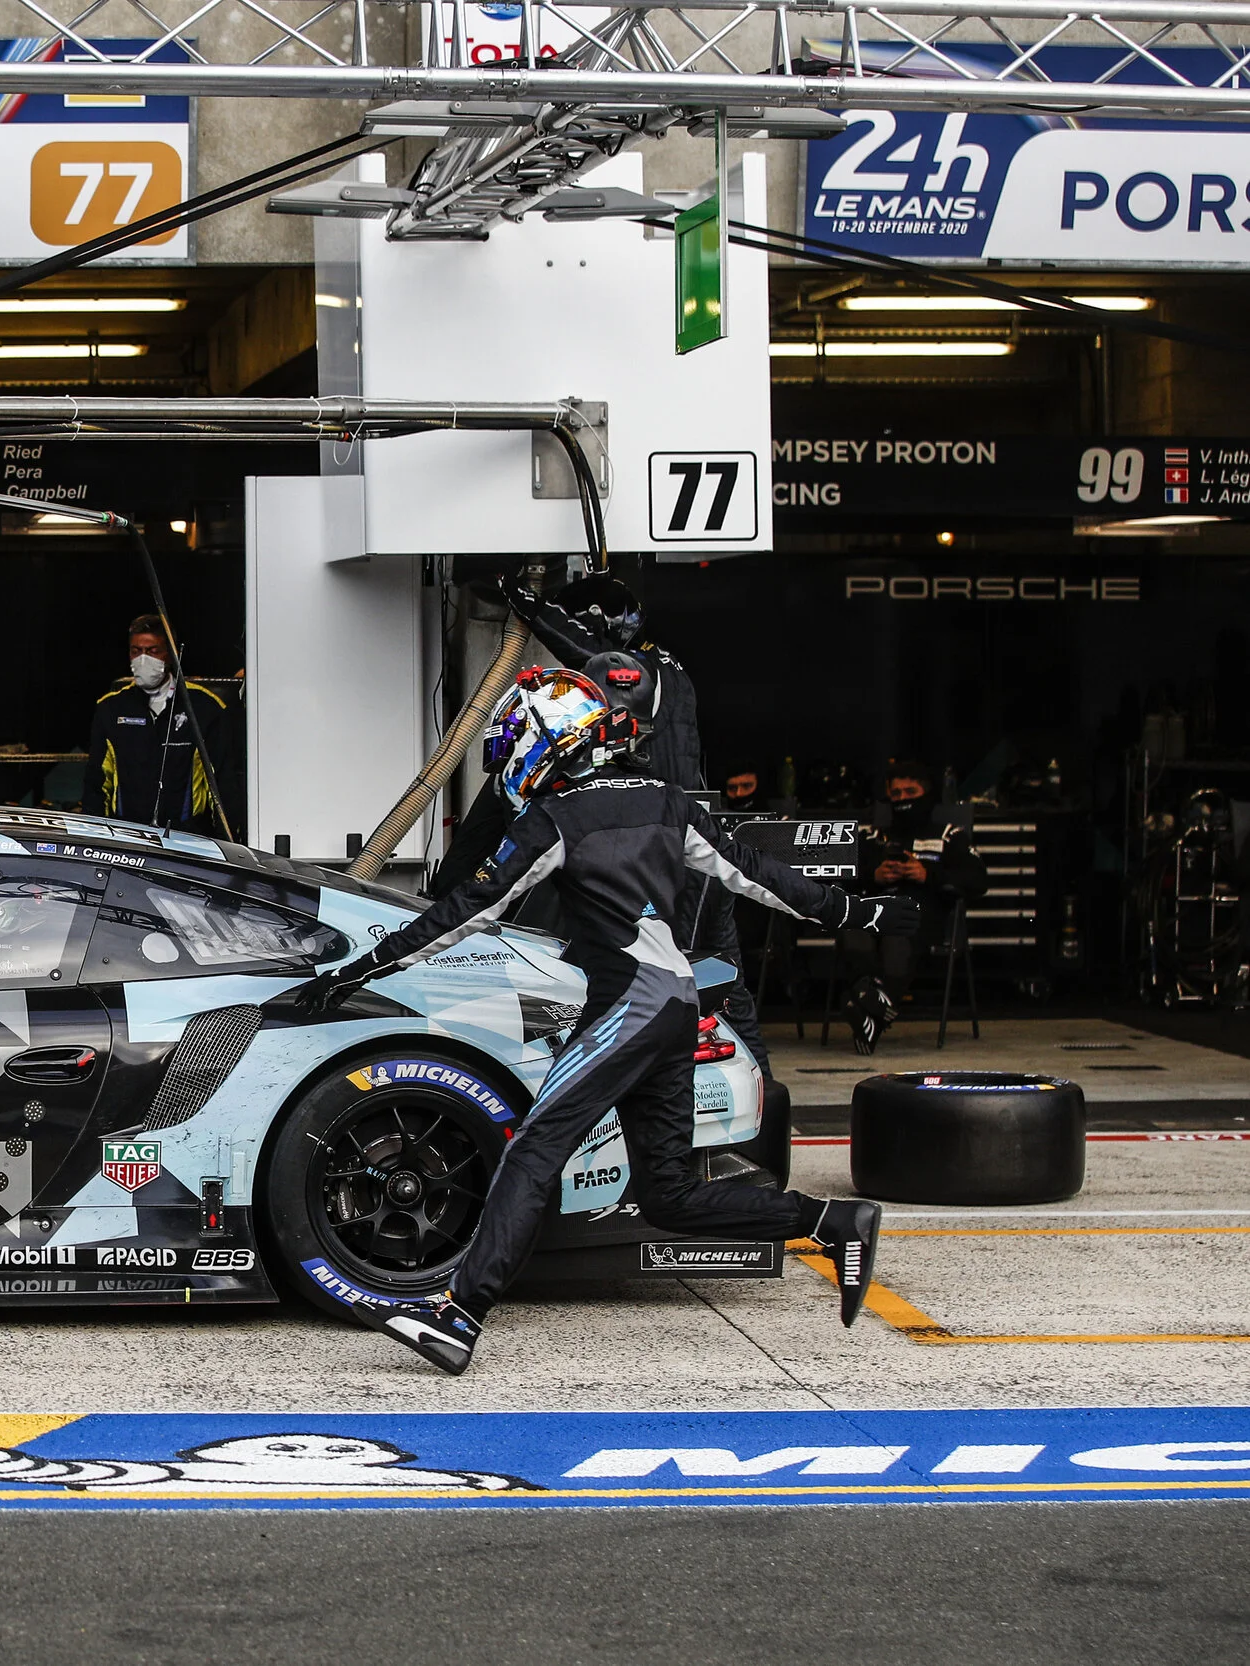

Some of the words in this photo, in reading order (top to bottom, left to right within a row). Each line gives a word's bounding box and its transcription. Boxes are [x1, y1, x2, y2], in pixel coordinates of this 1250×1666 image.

[821, 108, 990, 193] 24h
[60, 162, 153, 225] 77
[1060, 170, 1250, 234] POR
[813, 194, 858, 218] LE
[831, 220, 864, 233] 19-20
[868, 221, 937, 234] SEPTEMBRE
[939, 222, 967, 235] 2020
[3, 444, 42, 459] Ried
[771, 441, 868, 464] MPSEY
[876, 441, 996, 464] PROTON
[1200, 449, 1212, 464] V.
[1218, 449, 1250, 464] Inth
[4, 465, 43, 479] Pera
[1077, 447, 1144, 503] 99
[1200, 469, 1214, 484] L.
[7, 485, 87, 503] Campbell
[667, 462, 739, 531] 77
[771, 483, 841, 506] CING
[1200, 488, 1213, 503] J.
[846, 577, 1140, 600] PORSCHE
[63, 845, 78, 856] M.
[83, 848, 146, 868] Campbell
[425, 955, 470, 966] Cristian
[470, 951, 516, 962] Serafini
[394, 1064, 505, 1115] MICHELIN
[694, 1082, 727, 1091] Cartiere
[695, 1091, 728, 1101] Modesto
[696, 1099, 728, 1110] Cardella
[108, 1145, 156, 1160] TAG
[105, 1164, 158, 1190] HEUER
[573, 1166, 622, 1190] FARO
[116, 1249, 177, 1266] PAGID
[194, 1250, 253, 1270] BBS
[678, 1251, 761, 1262] MICHELIN
